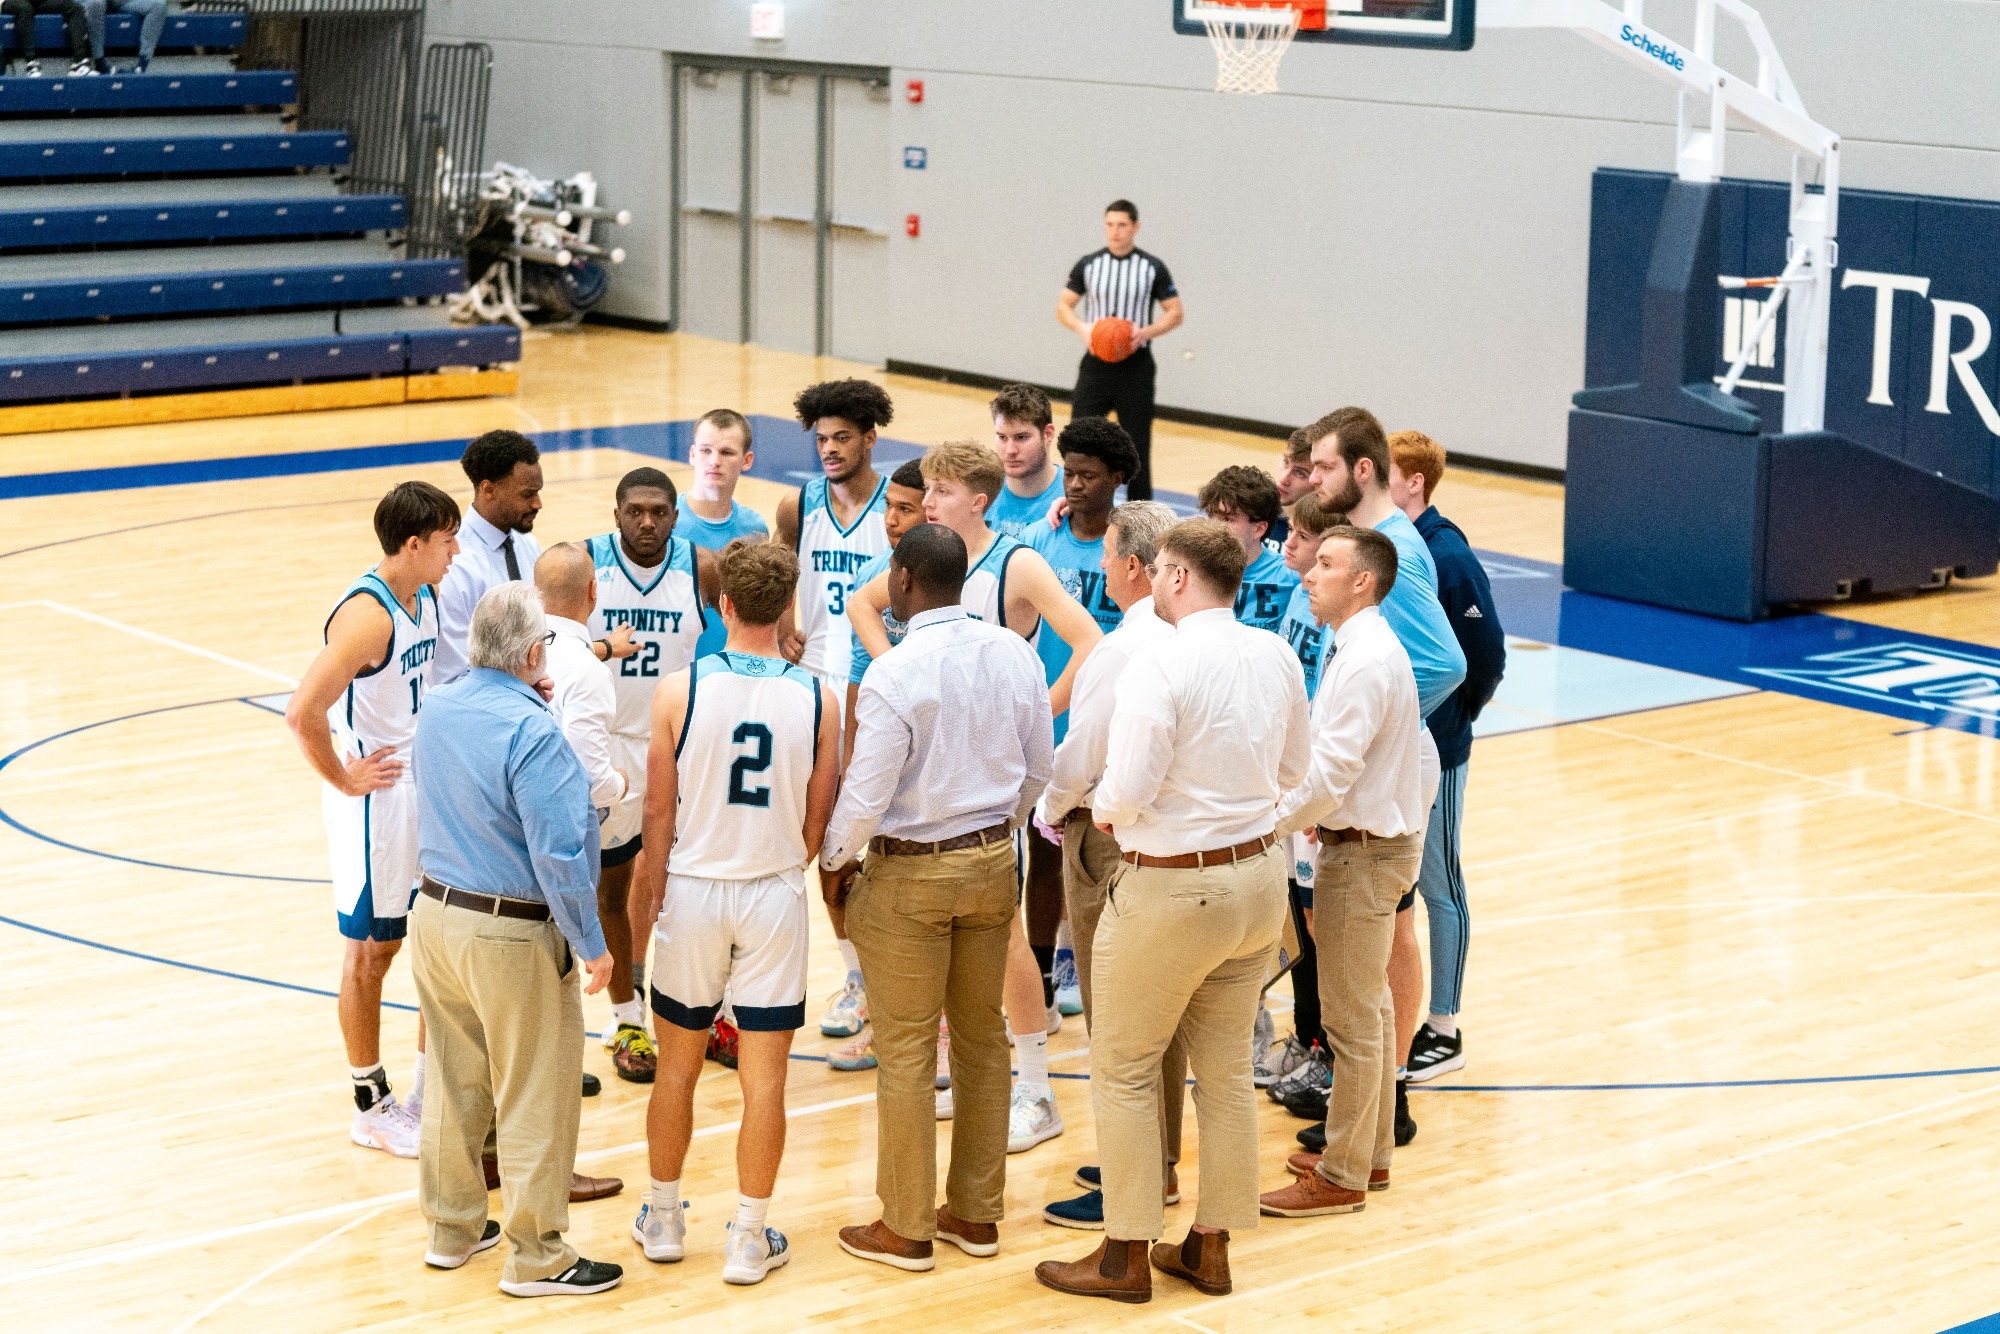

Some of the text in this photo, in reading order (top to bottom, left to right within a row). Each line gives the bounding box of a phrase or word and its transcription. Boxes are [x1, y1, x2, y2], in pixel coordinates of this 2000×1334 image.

[1620, 24, 1685, 71] Schelde
[811, 550, 873, 575] TRINIT
[827, 581, 855, 615] 3
[603, 608, 683, 633] TRINITY
[1091, 613, 1120, 625] OLLEGE
[620, 641, 661, 677] 22
[727, 721, 773, 809] 2
